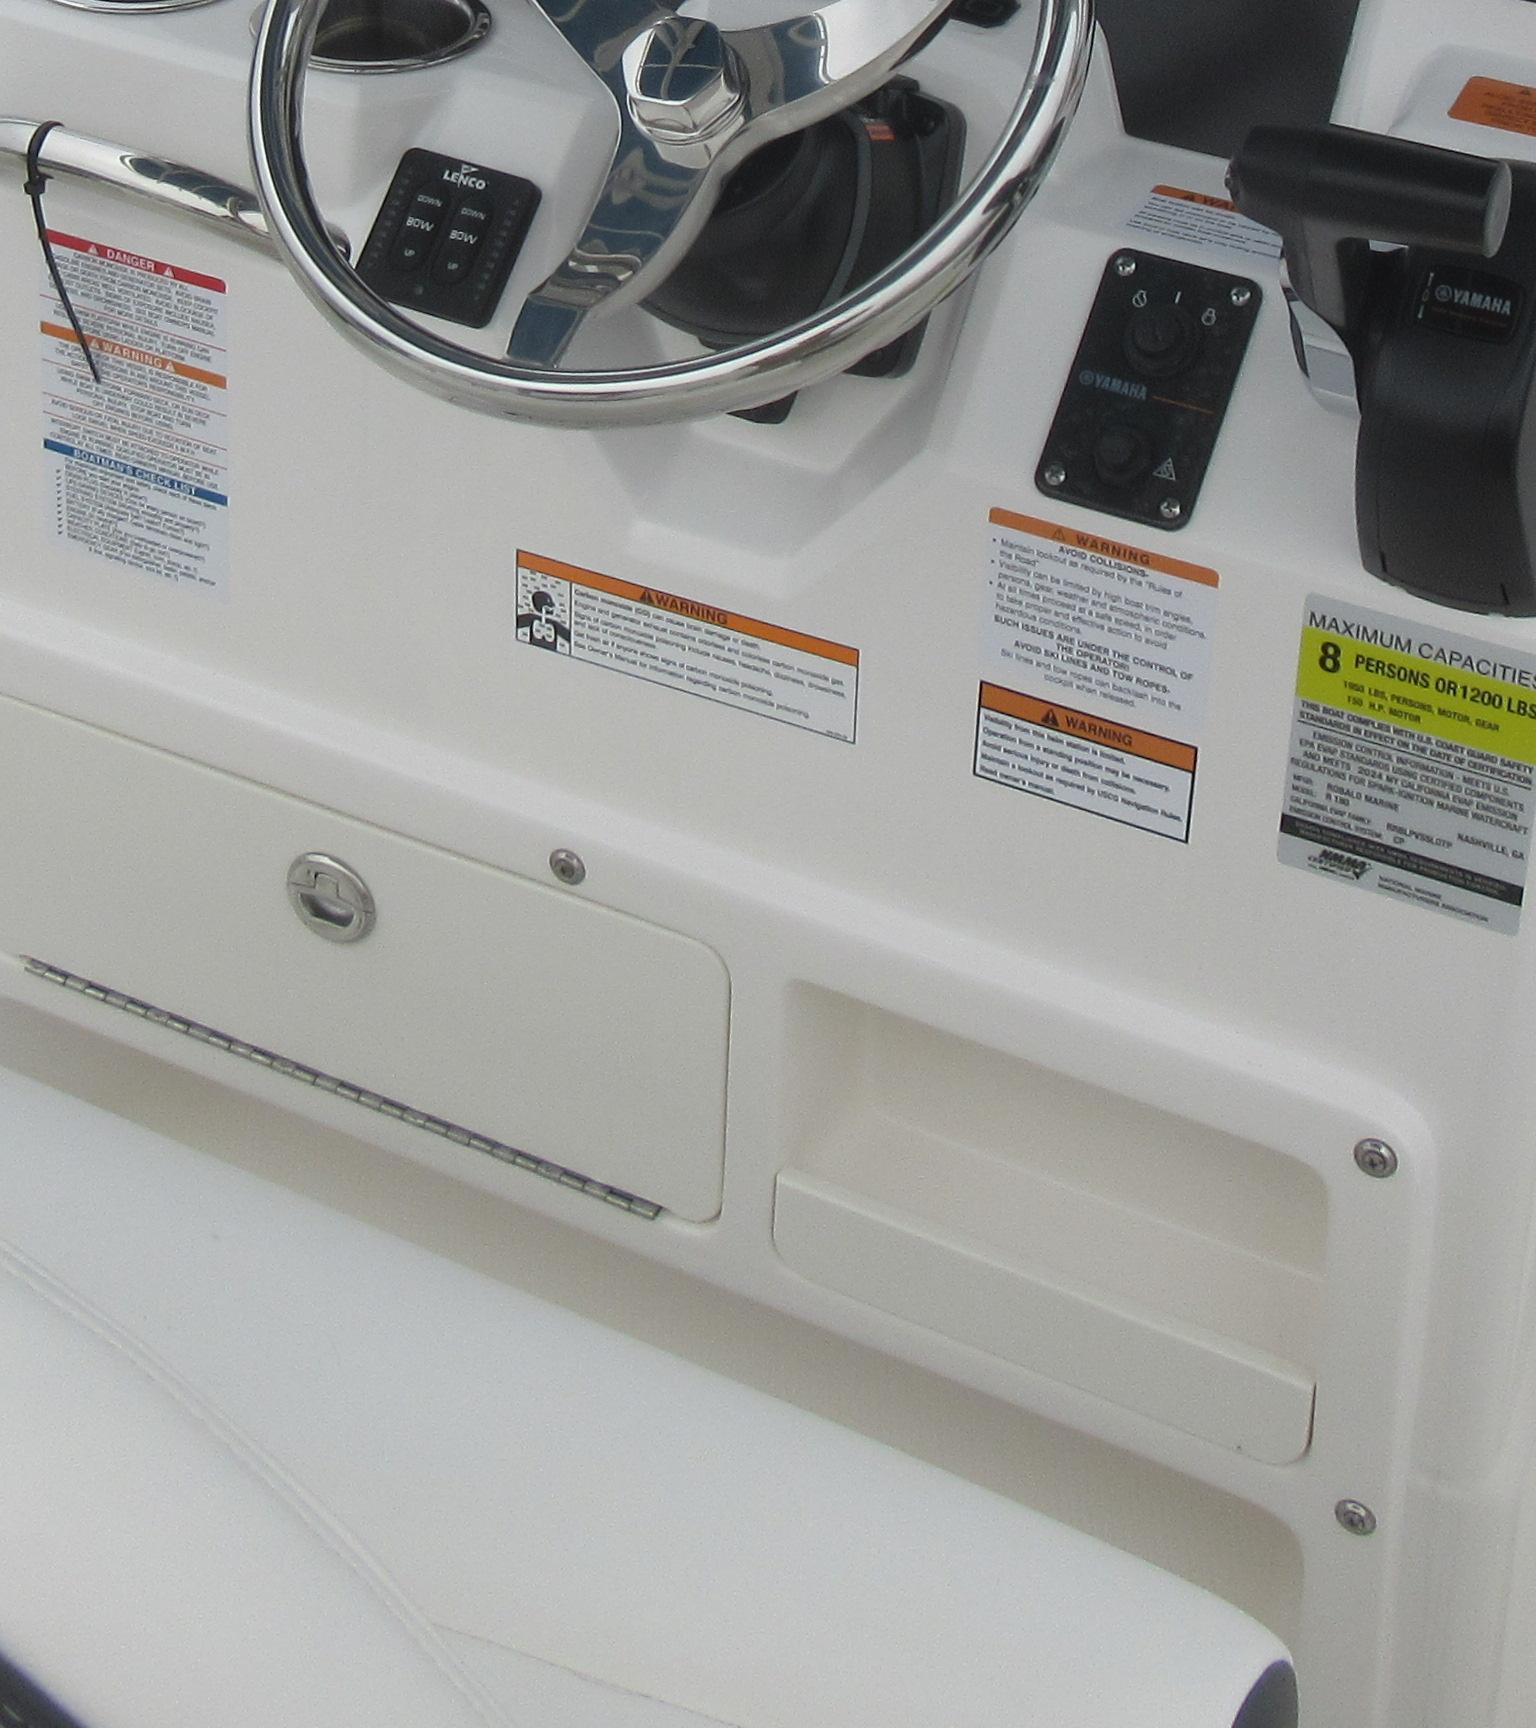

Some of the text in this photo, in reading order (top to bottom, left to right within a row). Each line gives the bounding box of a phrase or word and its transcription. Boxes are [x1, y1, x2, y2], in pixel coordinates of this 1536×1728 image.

[442, 170, 486, 190] LENCO
[417, 194, 486, 220] DOWN DOWN
[406, 216, 478, 245] BOW BOW
[106, 248, 154, 271] DANGER
[404, 248, 458, 270] UP UP
[1453, 288, 1511, 315] YAMAHA
[102, 341, 161, 368] WARNING
[1093, 374, 1148, 401] YAMAHA
[74, 448, 194, 495] BOATMAN'S CHECK LIST
[1058, 545, 1086, 560] AVOID
[1076, 534, 1149, 564] WARNING
[1036, 549, 1066, 564] lookout
[1116, 573, 1126, 583] by
[655, 593, 728, 626] WARNING
[1308, 611, 1411, 654] MAXIMUM
[993, 614, 1193, 681] SUCH ISSUES ARE UNDER THE CONTROL OF
[1014, 639, 1041, 655] AVOID
[1043, 648, 1058, 660] SKI
[1061, 653, 1087, 669] LINES
[1090, 662, 1109, 675] AND
[1111, 668, 1133, 683] TOW
[1056, 642, 1074, 655] THE
[1318, 639, 1342, 675] 8
[1354, 653, 1430, 689] PERSONS
[1434, 676, 1458, 696] OR
[1460, 683, 1503, 709] 1200
[1388, 706, 1421, 723] MOTOR
[1065, 715, 1132, 747] WARNING
[1301, 699, 1320, 712] THIS
[1322, 705, 1343, 719] BOAT
[1346, 712, 1390, 732] COMPLIES
[1392, 725, 1415, 739] WITH
[1434, 737, 1465, 754] COAST
[1466, 747, 1498, 763] GUARD
[1499, 756, 1533, 773] SAFETY
[1300, 710, 1532, 784] STANDARDS IN EFFECT ON THE DATE OF CERTIFICATION
[1357, 766, 1383, 781] 2024
[1326, 782, 1362, 800] ROBALO
[1364, 793, 1400, 811] MARINE
